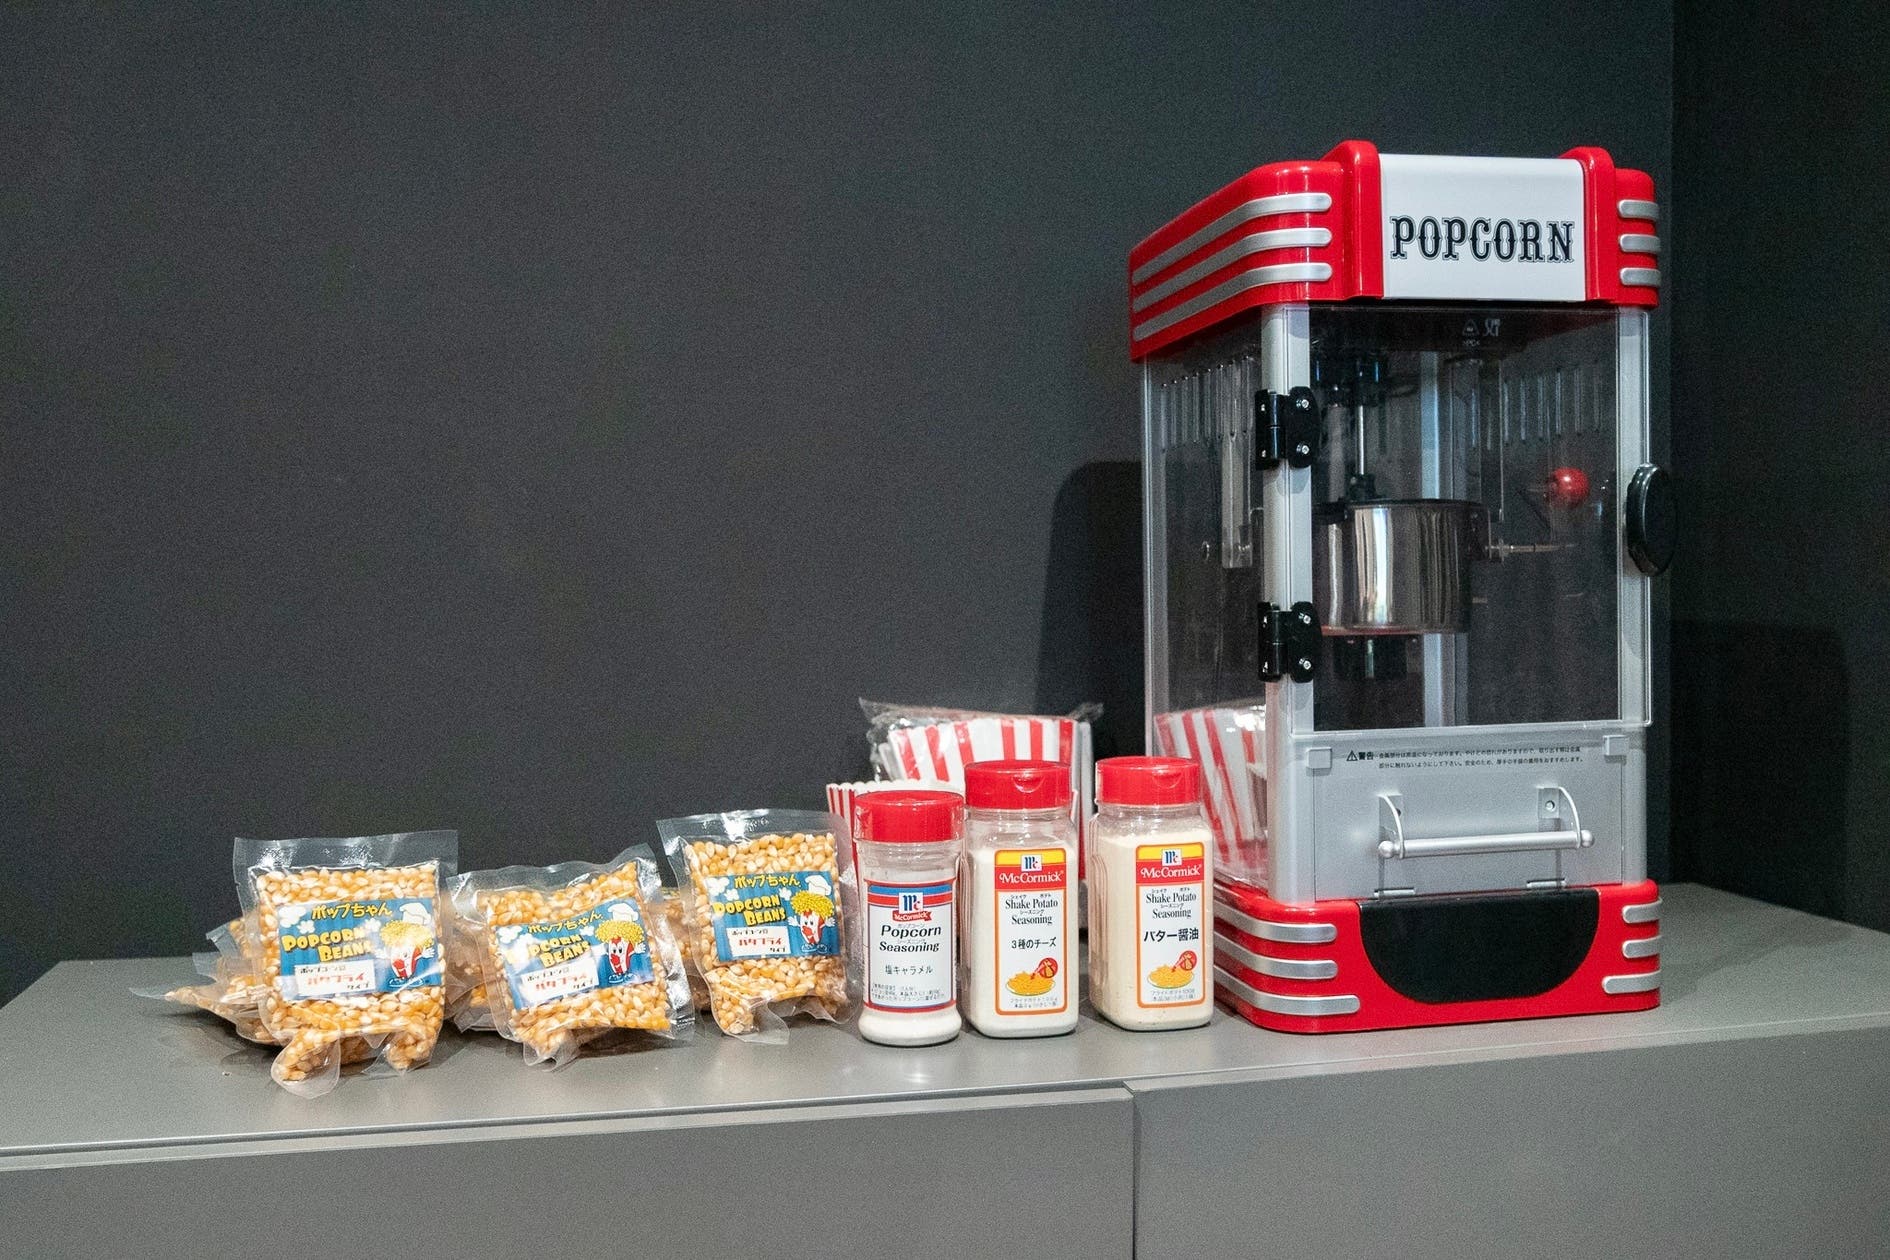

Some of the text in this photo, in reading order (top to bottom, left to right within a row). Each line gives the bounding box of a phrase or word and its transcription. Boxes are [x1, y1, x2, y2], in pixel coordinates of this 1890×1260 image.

[1390, 215, 1575, 263] POPCORN
[999, 871, 1062, 884] McCormick
[1140, 865, 1201, 878] McCormick
[735, 874, 801, 888] ポップちゃん
[712, 894, 781, 915] POPCORN
[1005, 898, 1058, 909] Shake Potato
[1146, 893, 1197, 904] Shake Potato
[311, 902, 392, 921] ポップちゃん
[743, 907, 788, 926] BEANS
[1152, 908, 1192, 919] Seasoning
[528, 910, 603, 934] ポップちゃん
[1011, 914, 1053, 926] Seasoning
[881, 924, 942, 939] Popcorn
[1144, 927, 1199, 942] バター醤油
[879, 941, 941, 953] Seasoning
[539, 941, 592, 968] BEANS
[885, 964, 933, 976] 塩キャラメル
